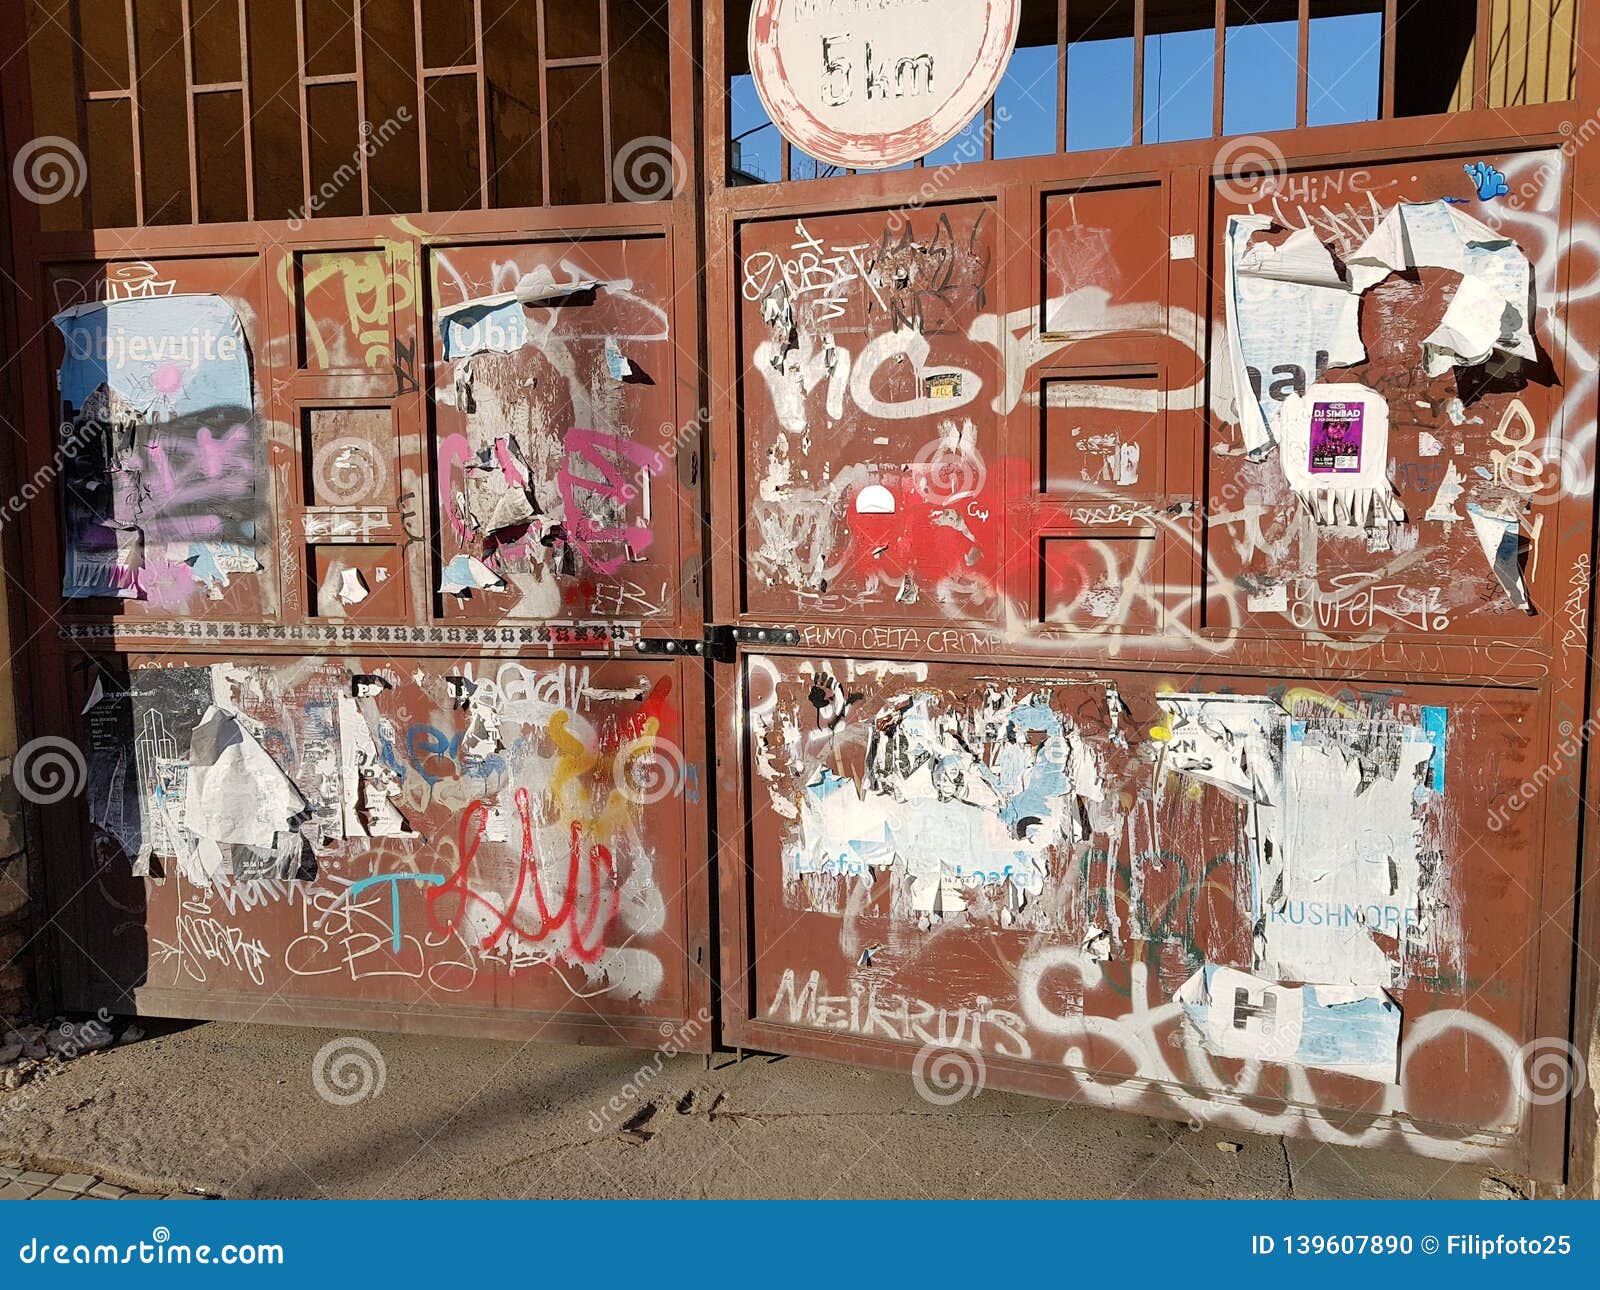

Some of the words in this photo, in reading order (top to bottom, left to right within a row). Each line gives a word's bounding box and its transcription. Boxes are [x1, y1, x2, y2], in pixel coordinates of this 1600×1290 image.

[821, 32, 853, 107] 5
[865, 40, 935, 100] km
[70, 328, 237, 370] Objevujte
[1314, 410, 1325, 418] DJ
[1326, 410, 1361, 418] SIMBAD
